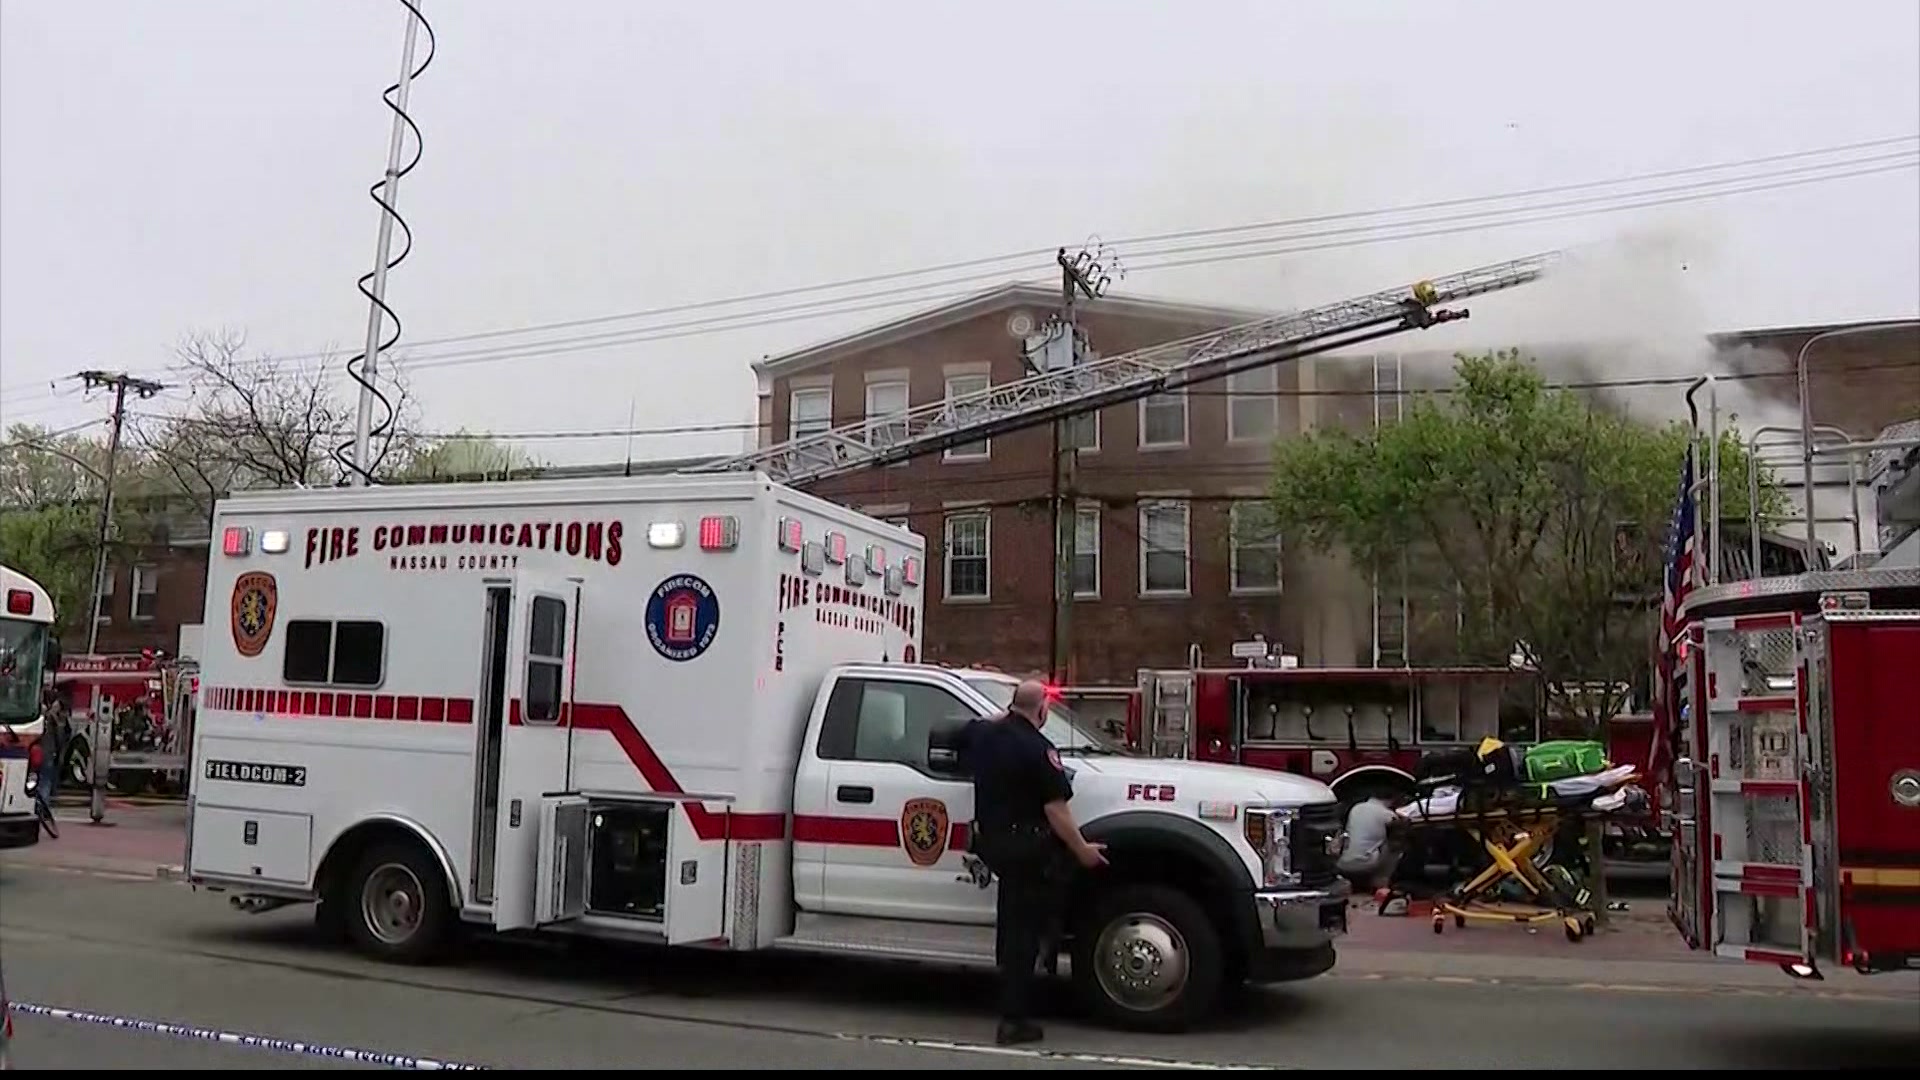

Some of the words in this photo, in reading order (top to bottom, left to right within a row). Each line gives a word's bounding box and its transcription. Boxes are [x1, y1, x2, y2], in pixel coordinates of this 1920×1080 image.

[304, 527, 360, 570] FIRE
[372, 521, 624, 567] COMMUNICATIONS
[389, 555, 448, 570] NASSAU
[458, 555, 519, 570] COUNTY
[656, 576, 711, 598] FIRECOM
[779, 573, 808, 613] FIRE
[815, 582, 916, 640] COMMUNICATIONS
[648, 622, 698, 658] ORGANIZED
[63, 661, 106, 671] FLORAL
[109, 660, 138, 671] PARK
[206, 762, 306, 785] FIELDCOM-2
[1127, 784, 1175, 802] FC2
